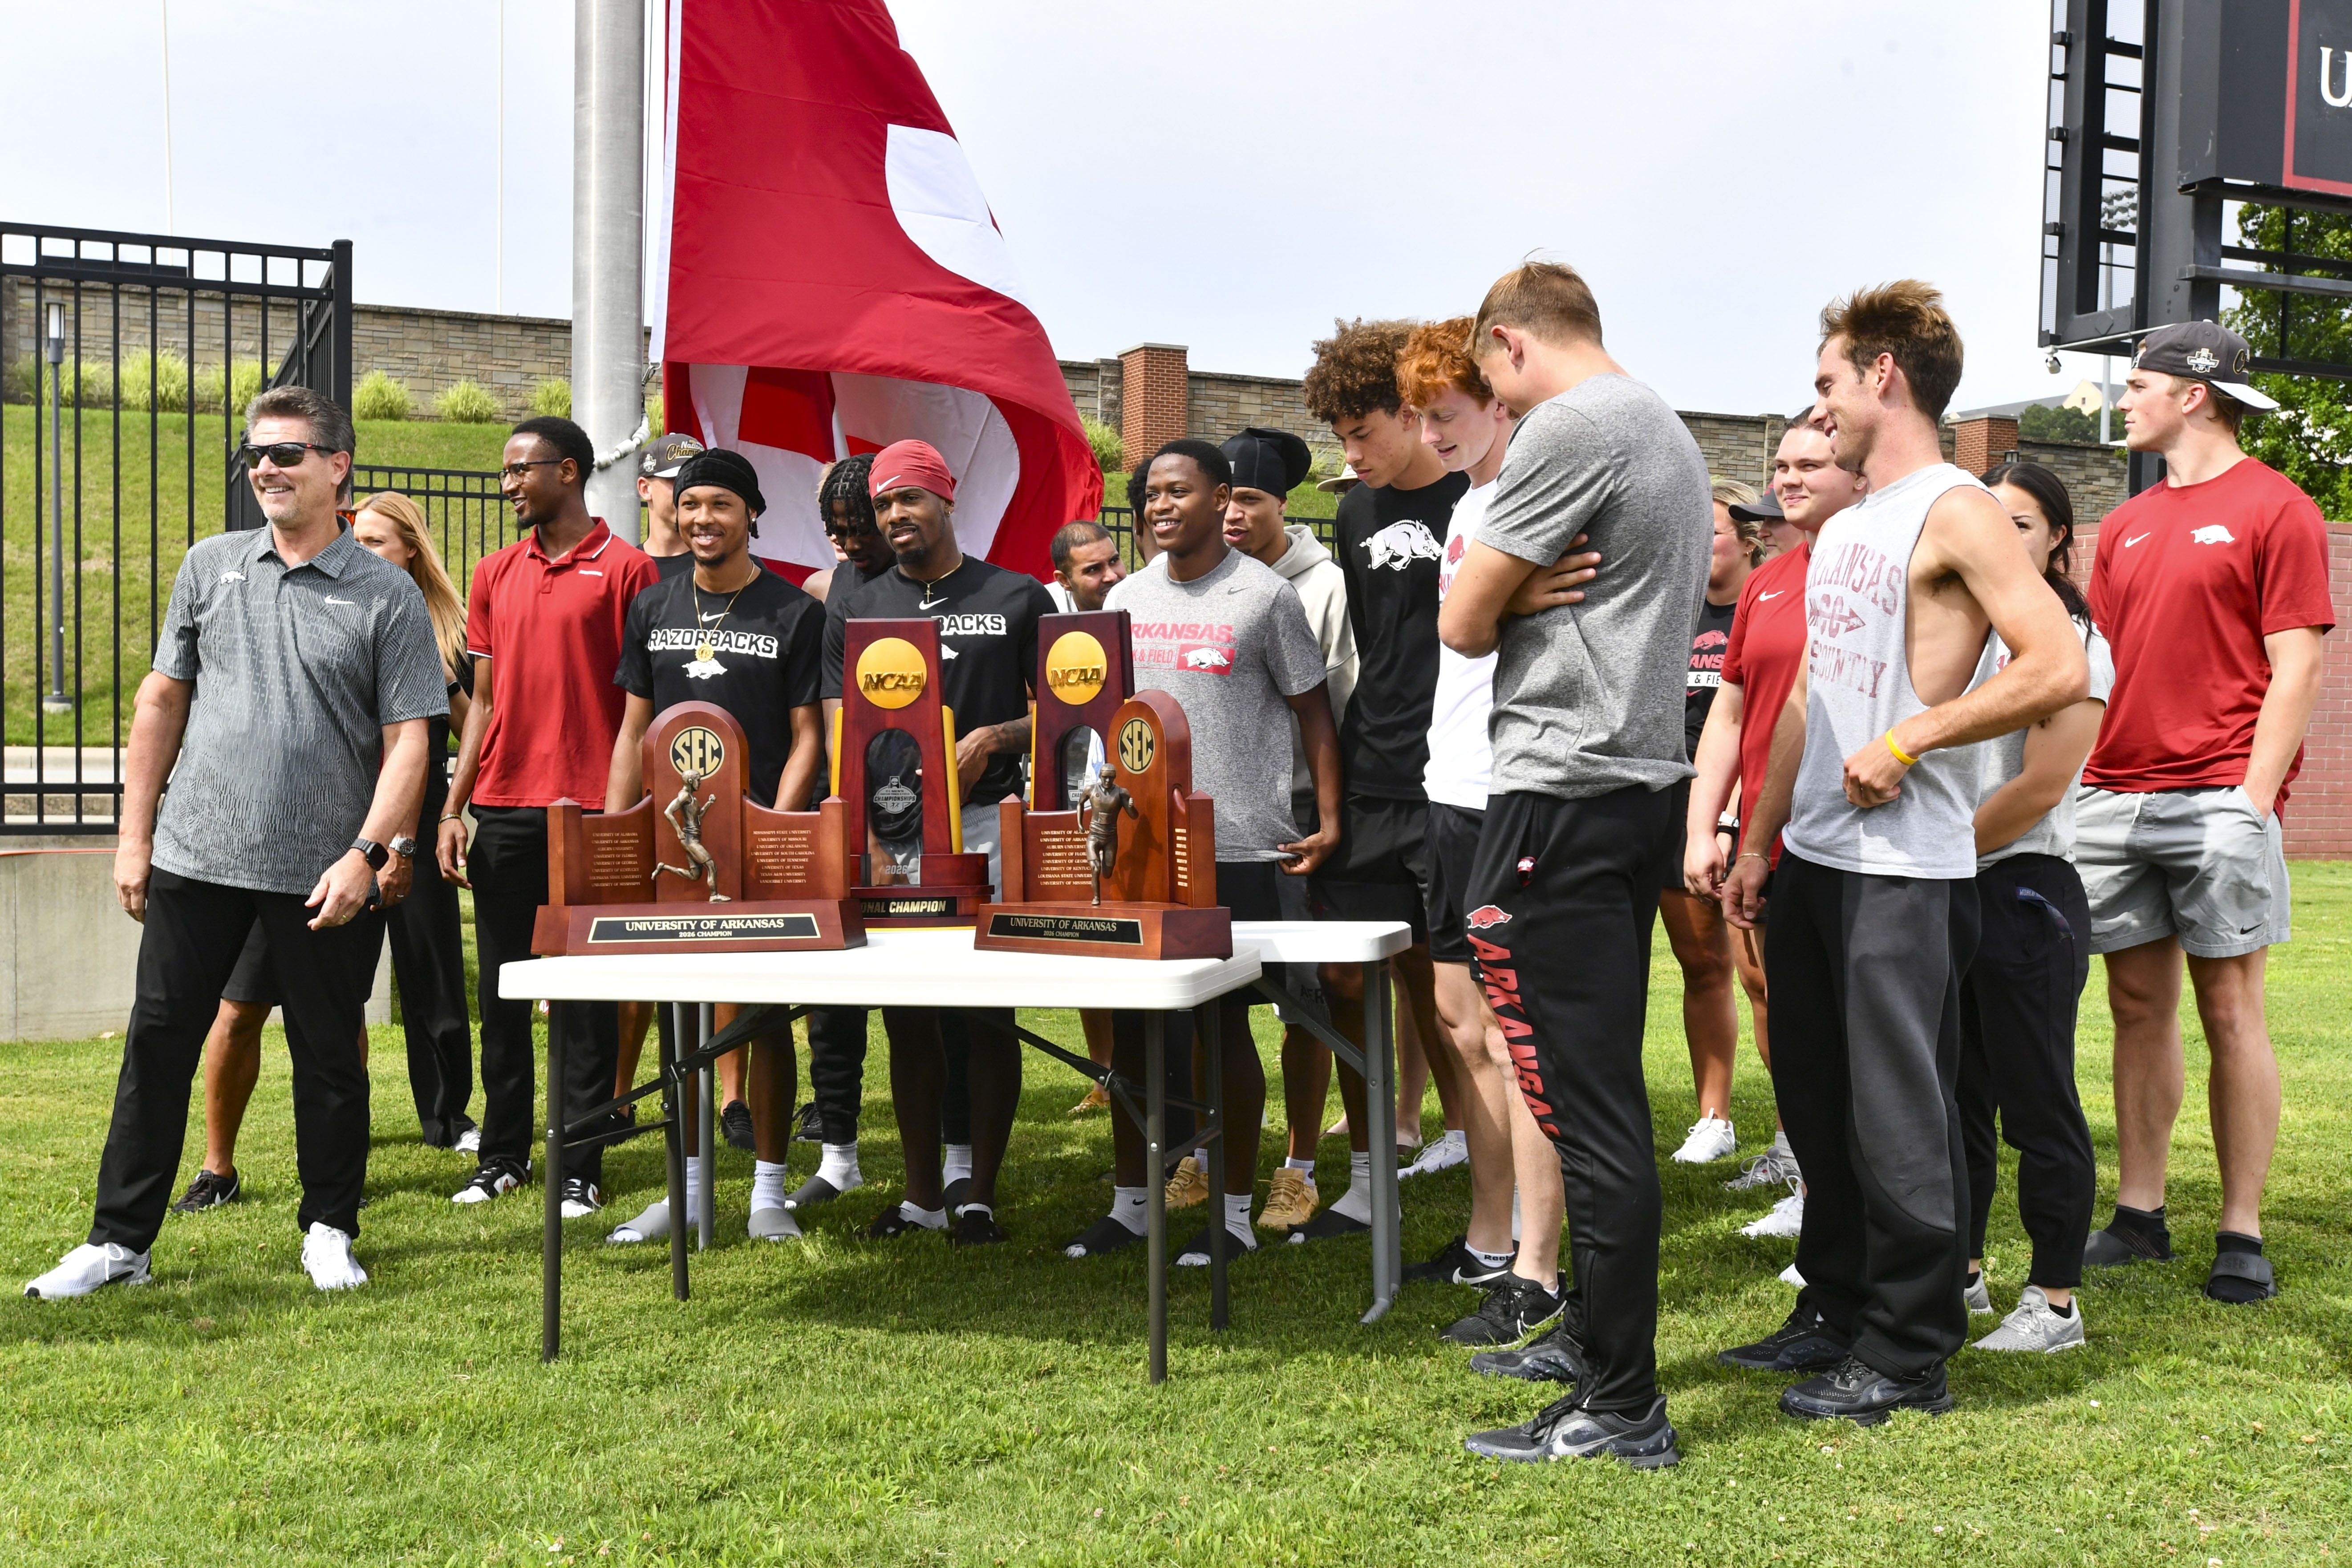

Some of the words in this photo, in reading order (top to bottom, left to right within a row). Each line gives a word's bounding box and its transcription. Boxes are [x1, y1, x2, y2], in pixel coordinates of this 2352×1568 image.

[2320, 47, 2352, 108] U
[648, 629, 777, 657] RAZORBACKS
[1148, 648, 1173, 663] FIELD
[863, 672, 924, 691] NCAA
[1050, 665, 1105, 688] NCAA
[674, 729, 720, 776] SEC
[1121, 721, 1152, 771] SEC
[885, 865, 908, 874] 2026
[889, 900, 946, 913] CHAMPION
[625, 920, 697, 932] UNIVERSITY
[701, 919, 717, 930] OF
[720, 918, 785, 929] ARKANSAS
[1010, 917, 1057, 928] UNIVERSITY
[1058, 920, 1070, 929] OF
[1072, 921, 1117, 932] ARKANSAS
